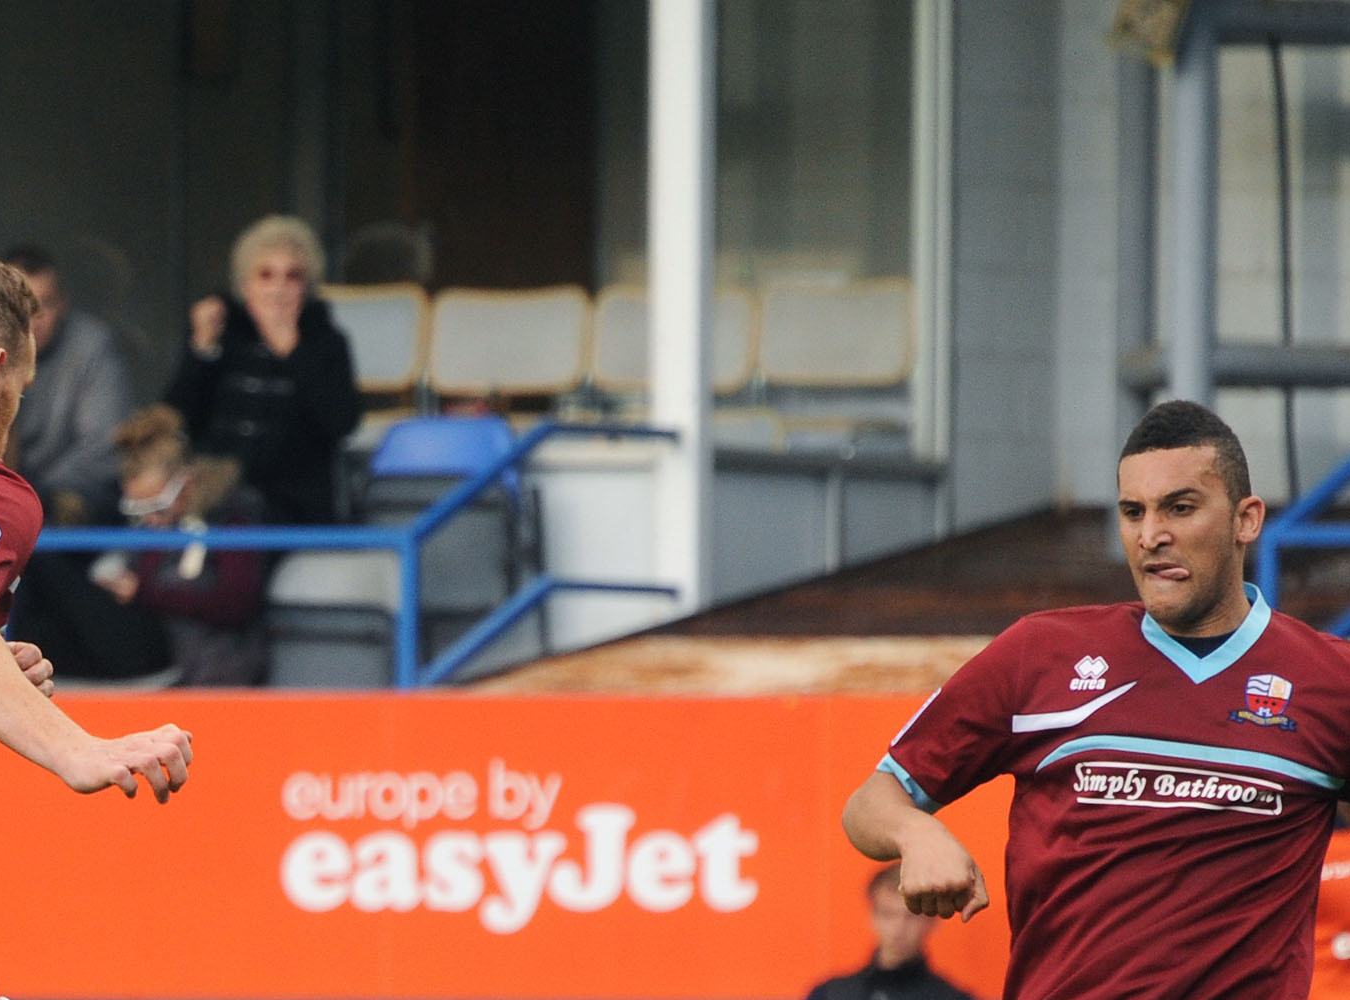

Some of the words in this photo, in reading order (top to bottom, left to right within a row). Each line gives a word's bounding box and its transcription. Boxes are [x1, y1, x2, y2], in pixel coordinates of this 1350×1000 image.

[281, 770, 478, 829] europe
[488, 757, 562, 831] by
[1073, 765, 1147, 801] Simply
[280, 803, 760, 935] easyJet
